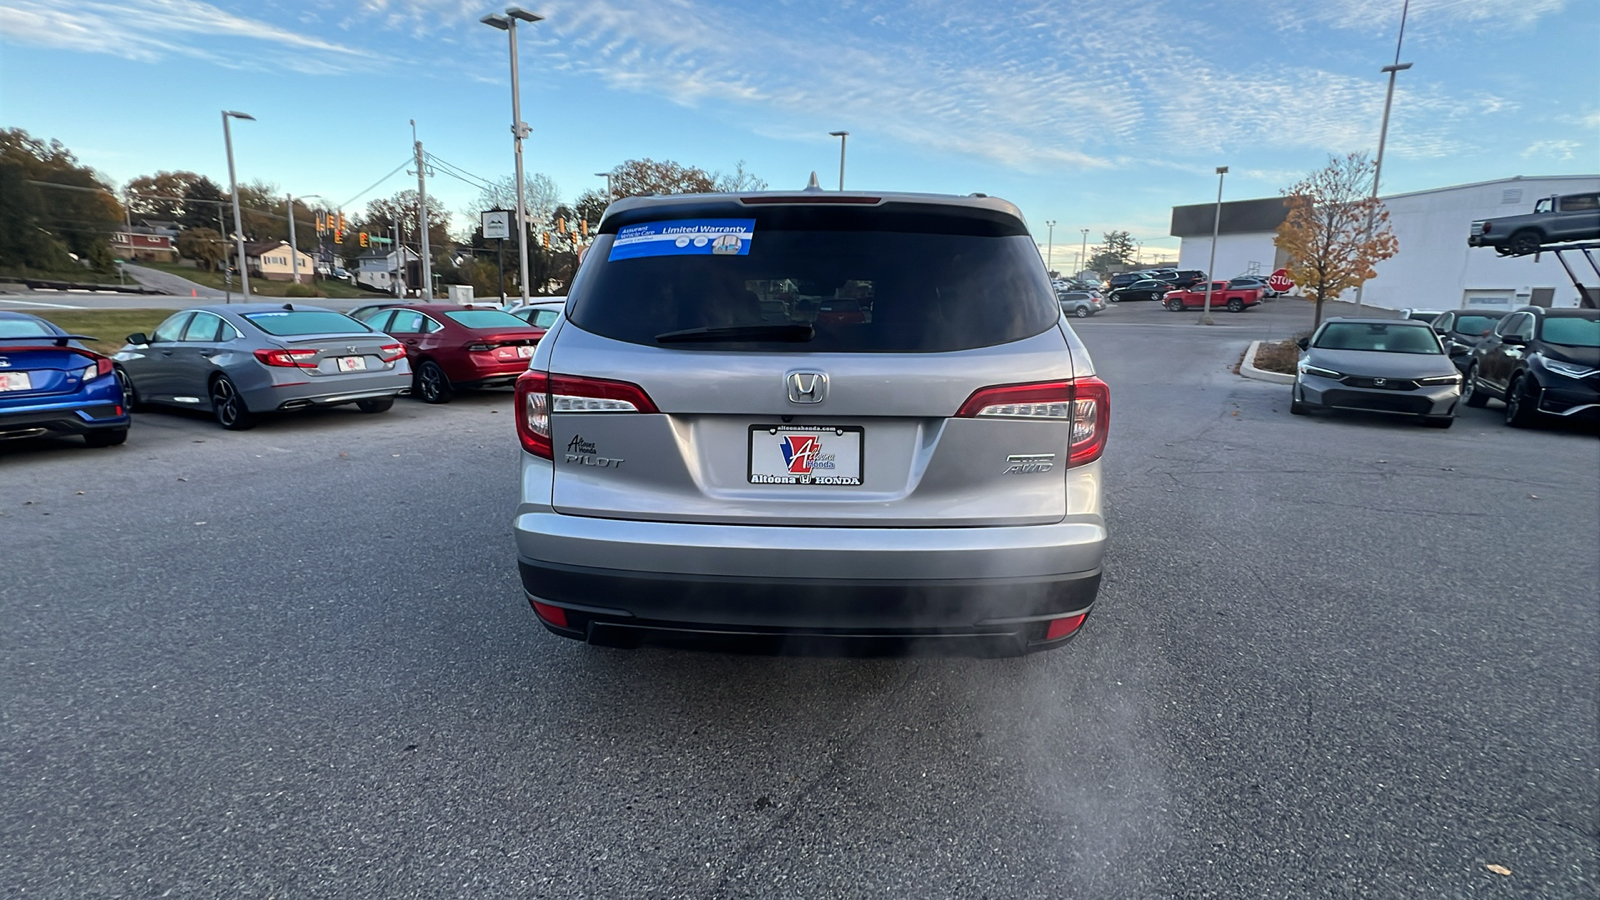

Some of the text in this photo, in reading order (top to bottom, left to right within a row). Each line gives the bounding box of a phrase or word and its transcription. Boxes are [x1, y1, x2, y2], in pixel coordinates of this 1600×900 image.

[622, 226, 648, 234] Assurant
[662, 225, 747, 234] Limited Warranty
[620, 231, 641, 239] Vehicle
[565, 454, 625, 468] PILOT
[807, 460, 835, 469] Honda
[751, 474, 797, 484] Altoona
[815, 476, 861, 485] HONDA
